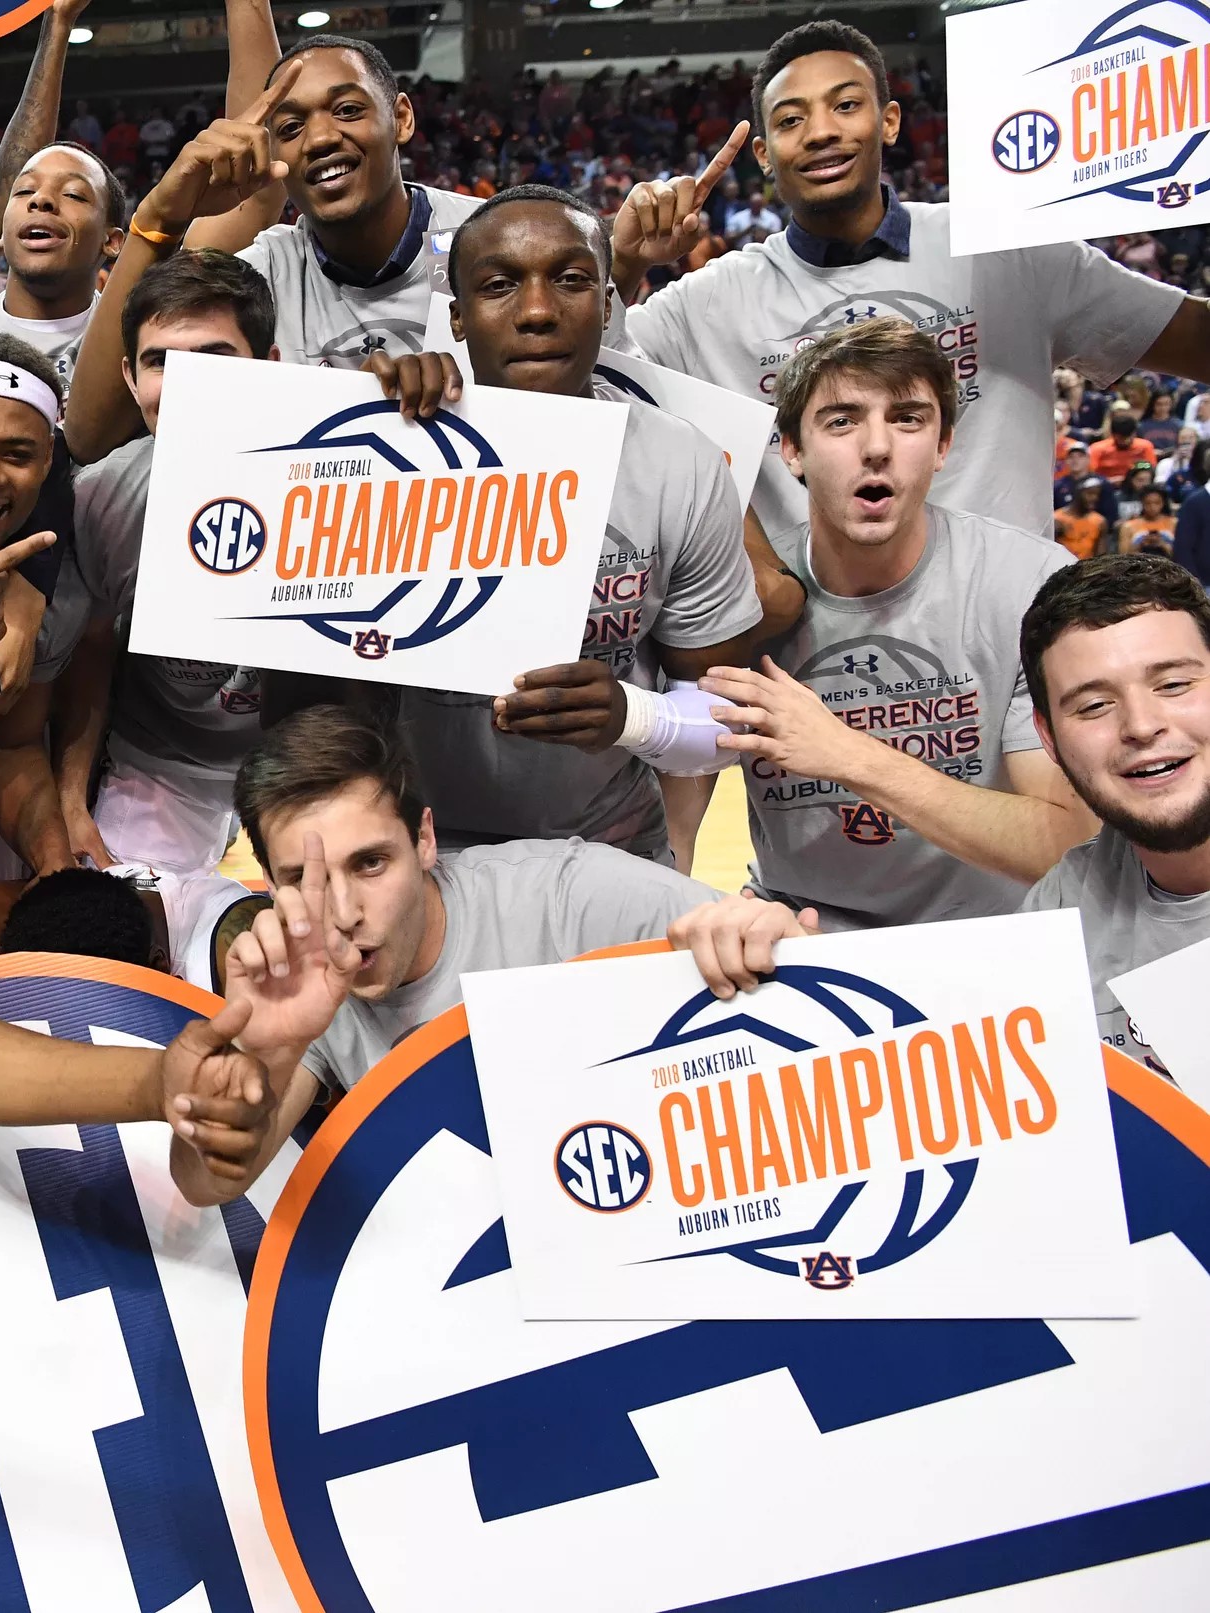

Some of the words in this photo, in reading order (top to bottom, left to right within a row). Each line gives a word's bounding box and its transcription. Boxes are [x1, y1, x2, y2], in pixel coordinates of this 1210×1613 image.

[1071, 64, 1091, 83] 2018
[1093, 46, 1146, 76] BASKETBALL
[1072, 42, 1210, 163] CHAM
[995, 112, 1057, 171] SEC
[1073, 159, 1110, 184] AUBURN
[1114, 148, 1148, 172] TIGERS
[288, 462, 311, 481] 2018
[313, 458, 372, 479] BASKETBALL
[192, 501, 263, 572] SEC
[275, 469, 579, 580] CHAMPIONS
[271, 583, 313, 603] AUBURN
[316, 581, 354, 600] TIGERS
[821, 686, 869, 703] MEN'S
[876, 672, 974, 696] BASKETBALL
[651, 1065, 681, 1089] 2018
[683, 1044, 757, 1083] BASKETBALL
[658, 1005, 1058, 1208] CHAMPIONS
[560, 1126, 651, 1209] SEC
[677, 1209, 730, 1238] AUBURN
[733, 1197, 782, 1226] TIGERS
